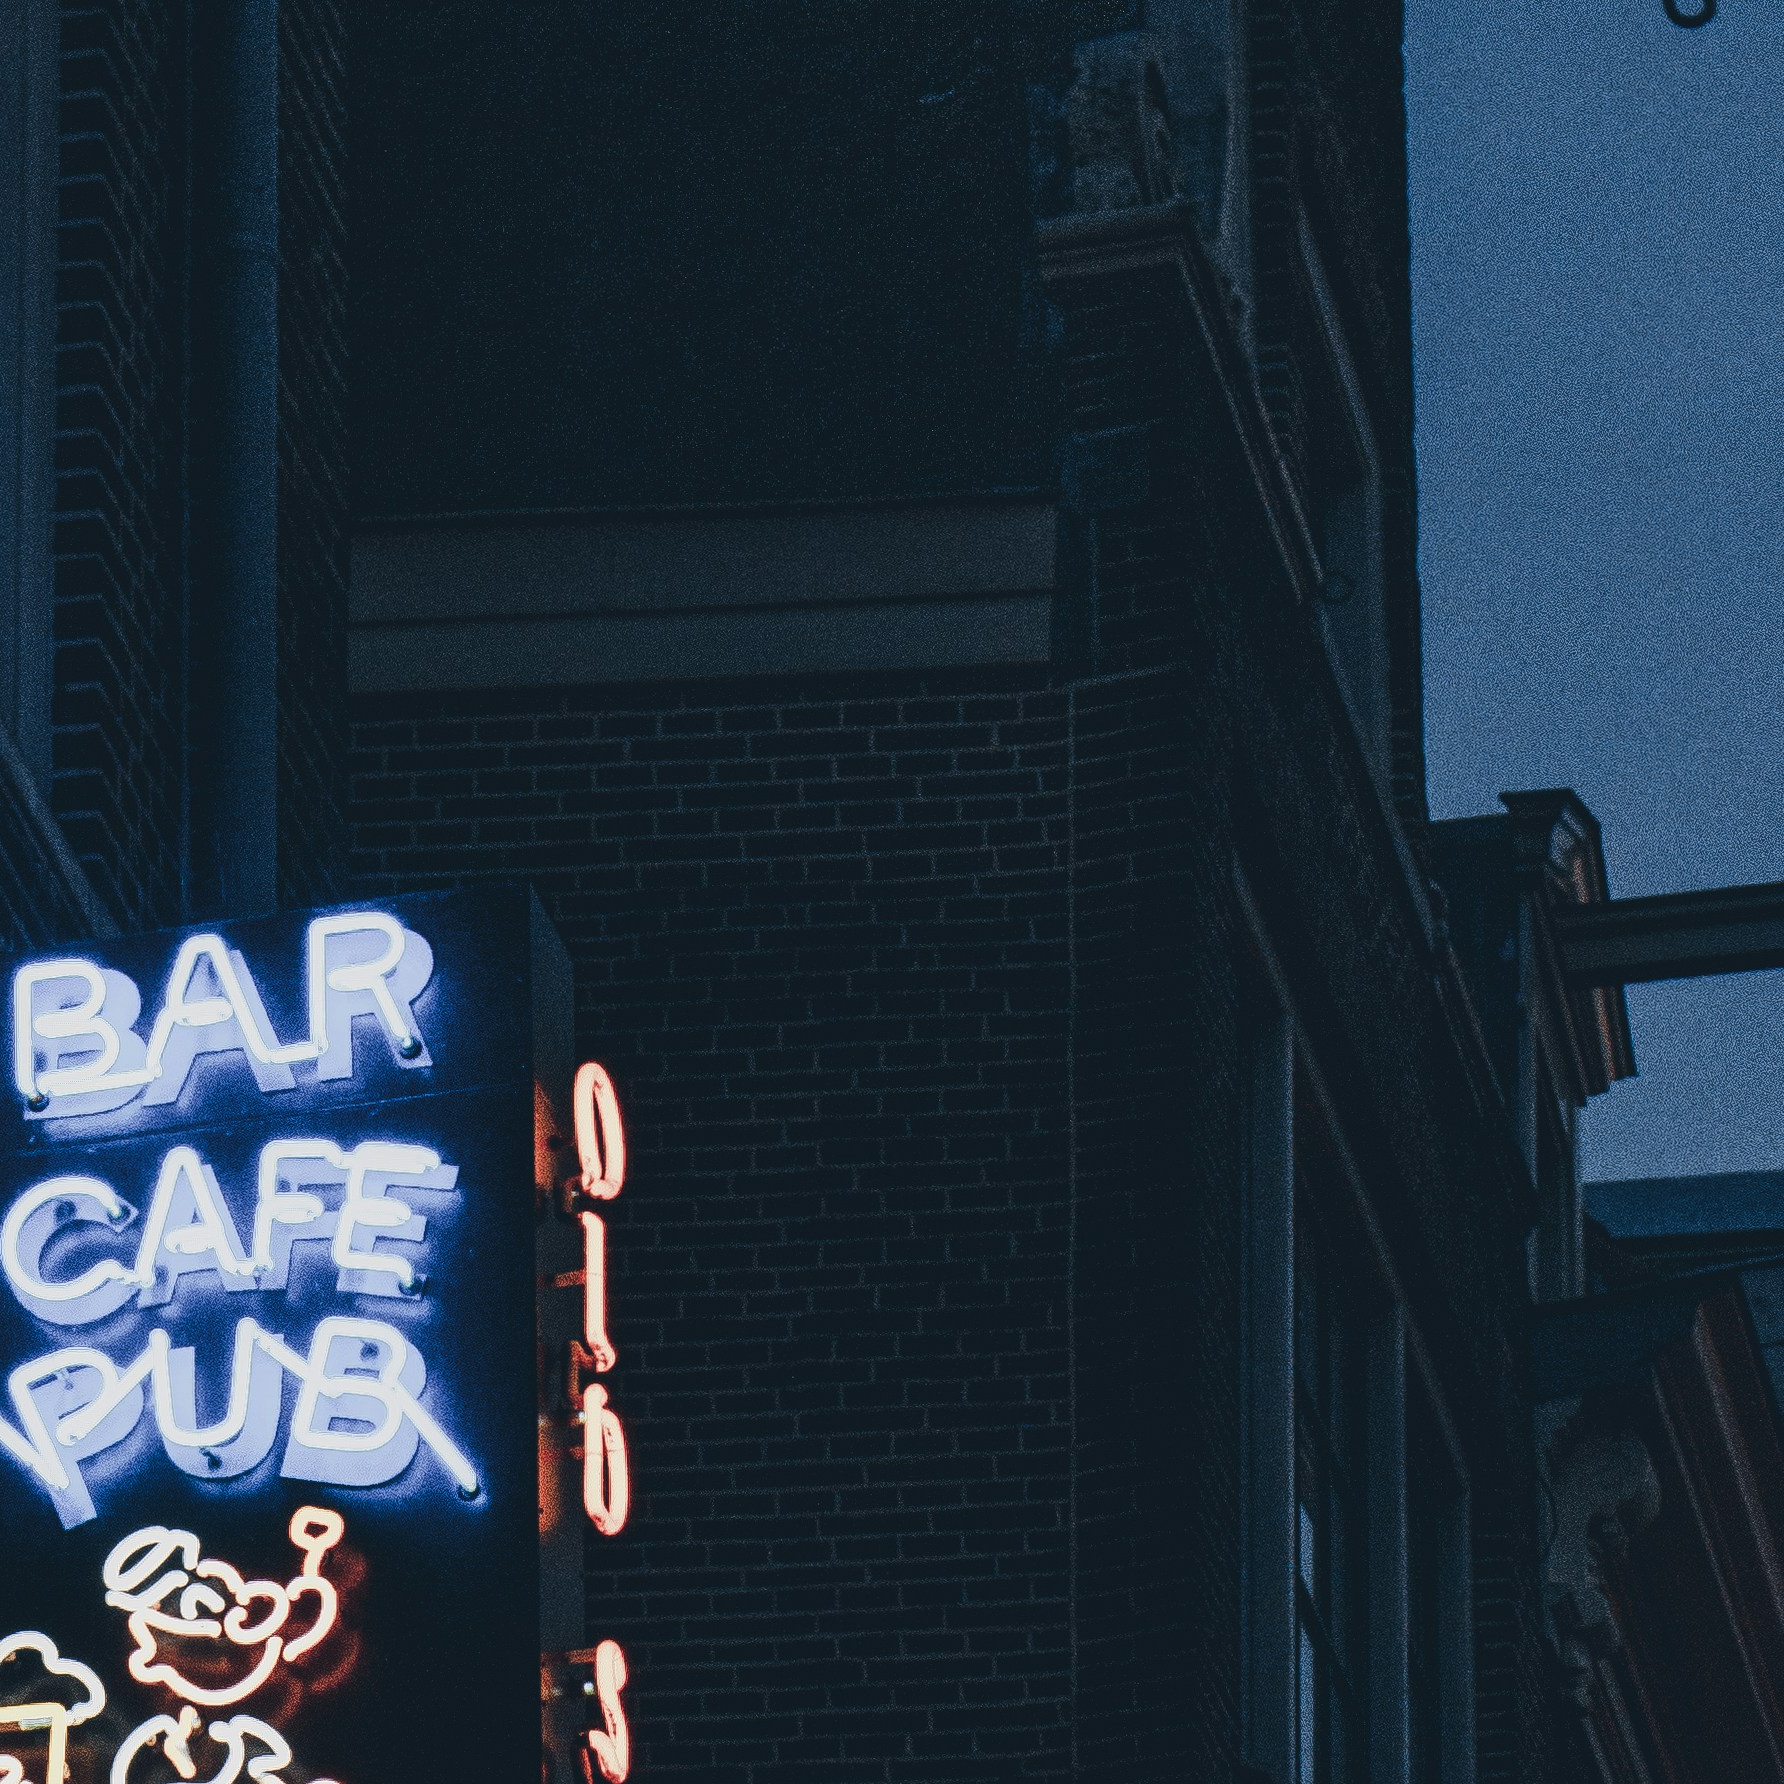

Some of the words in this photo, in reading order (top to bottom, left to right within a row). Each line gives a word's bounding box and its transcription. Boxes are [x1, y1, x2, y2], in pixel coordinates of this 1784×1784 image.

[12, 910, 433, 1120] BAR
[0, 1138, 460, 1325] CAFE
[573, 1060, 631, 1538] OLD
